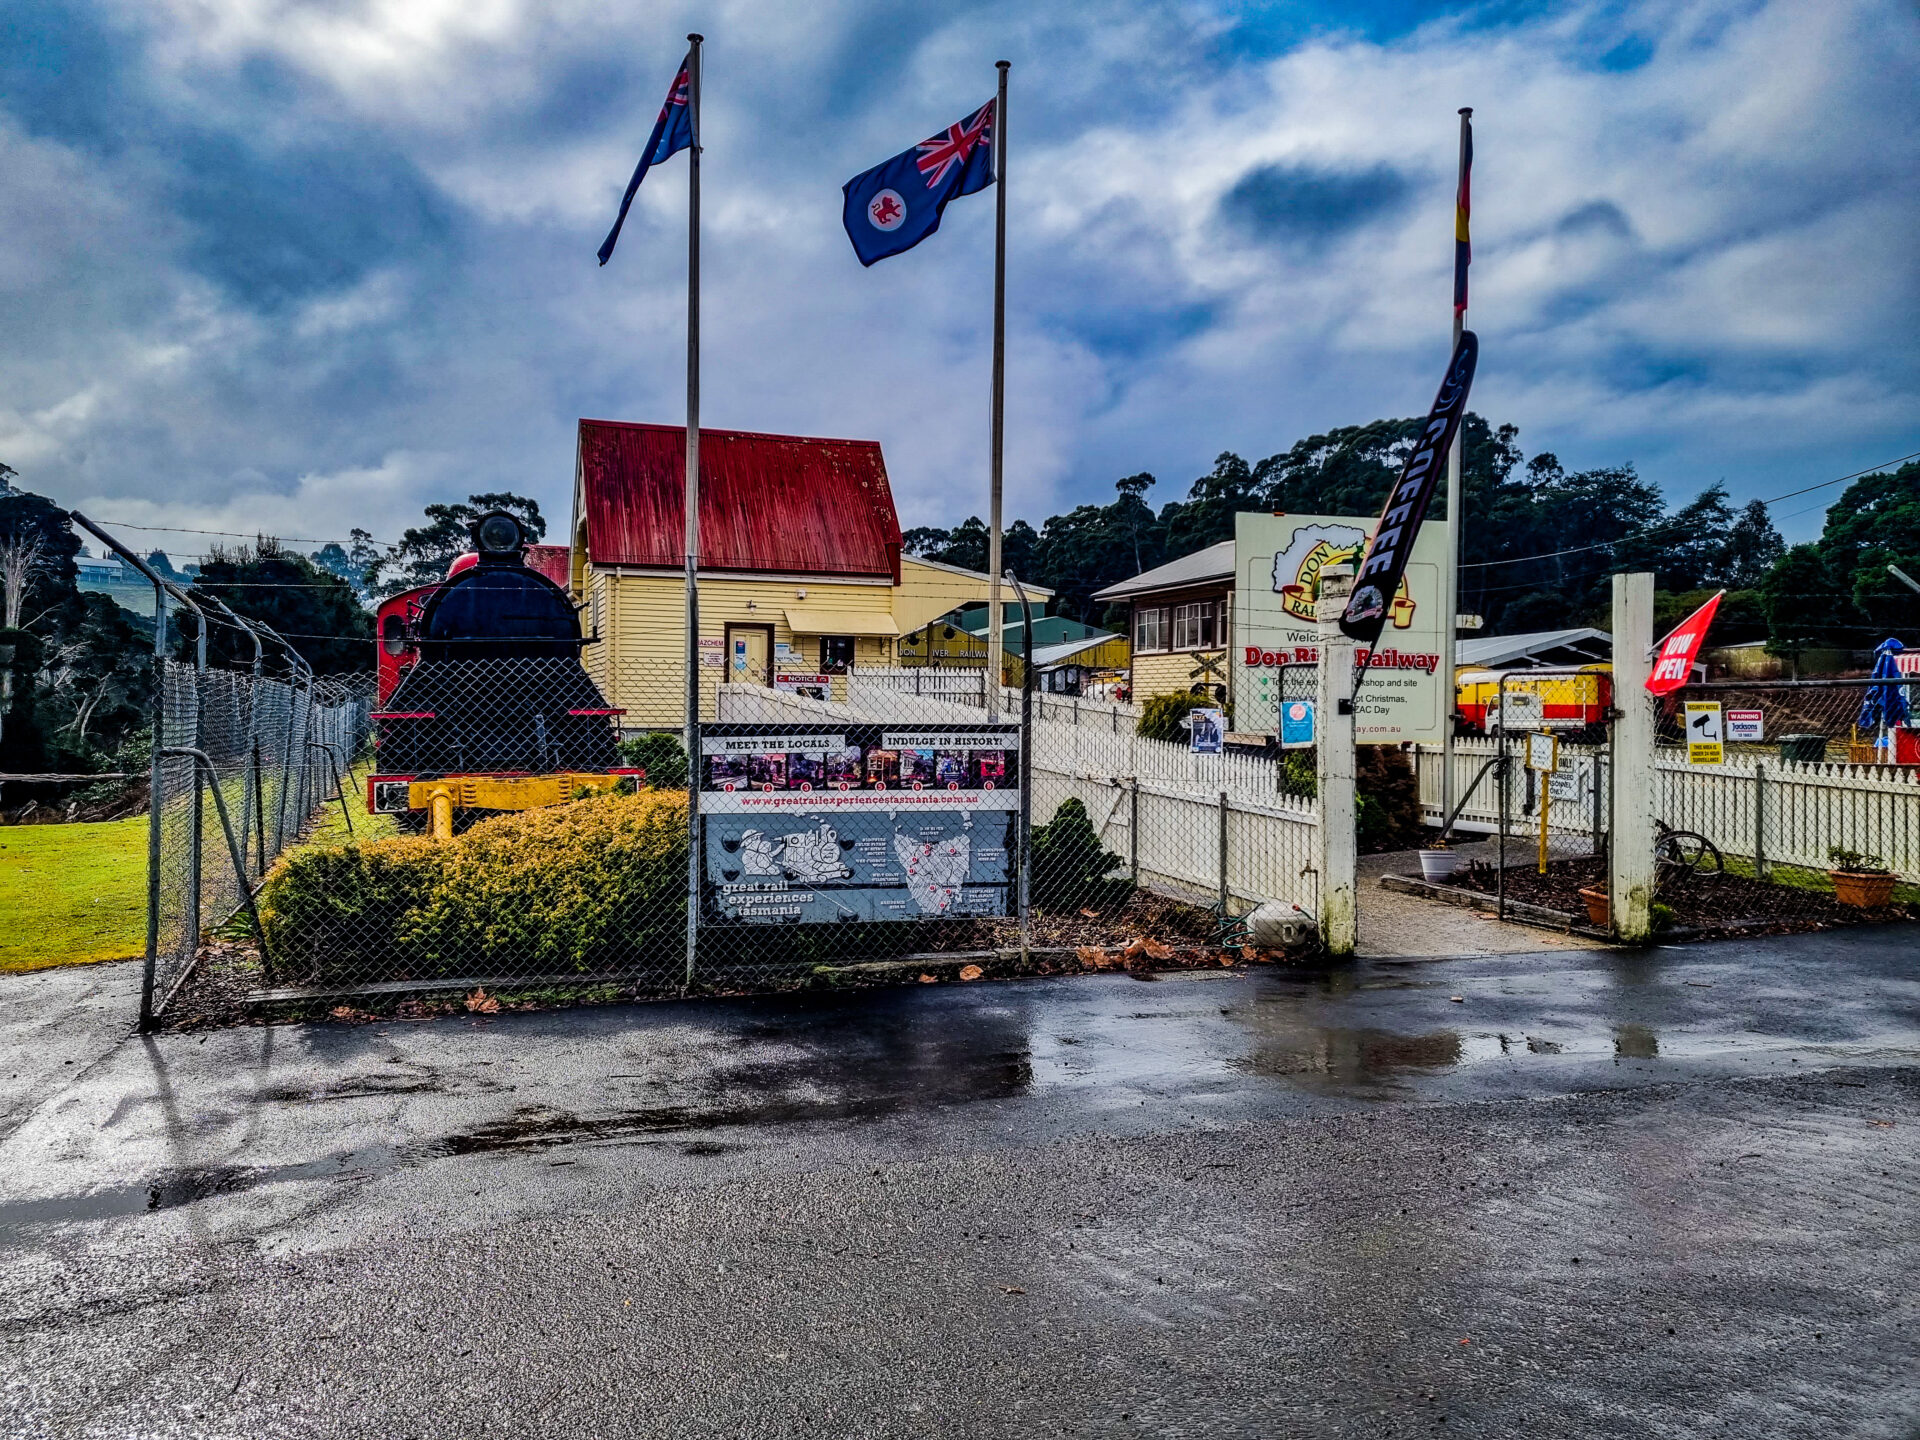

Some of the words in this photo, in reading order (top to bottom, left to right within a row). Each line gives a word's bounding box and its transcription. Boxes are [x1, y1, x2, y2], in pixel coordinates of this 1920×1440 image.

[1300, 546, 1329, 586] DON
[1286, 632, 1318, 642] Welc
[932, 649, 949, 657] IVER
[1245, 647, 1290, 667] Don
[1355, 648, 1439, 672] Railway
[1654, 658, 1687, 681] PEN
[1387, 679, 1402, 687] and
[1403, 679, 1418, 687] site
[1365, 694, 1408, 704] Christmas,
[1374, 706, 1390, 715] Day
[725, 741, 759, 750] MEET
[762, 741, 785, 749] THE
[887, 737, 936, 746] INDULGE
[939, 737, 951, 746] IN
[1558, 757, 1573, 768] ONLY
[1549, 787, 1563, 795] ONLY
[741, 795, 979, 807] www.greatrailexperiencestasmania.com.au
[722, 881, 760, 896] great
[763, 880, 789, 892] rail
[728, 892, 814, 907] experiences
[739, 904, 802, 916] tasmania
